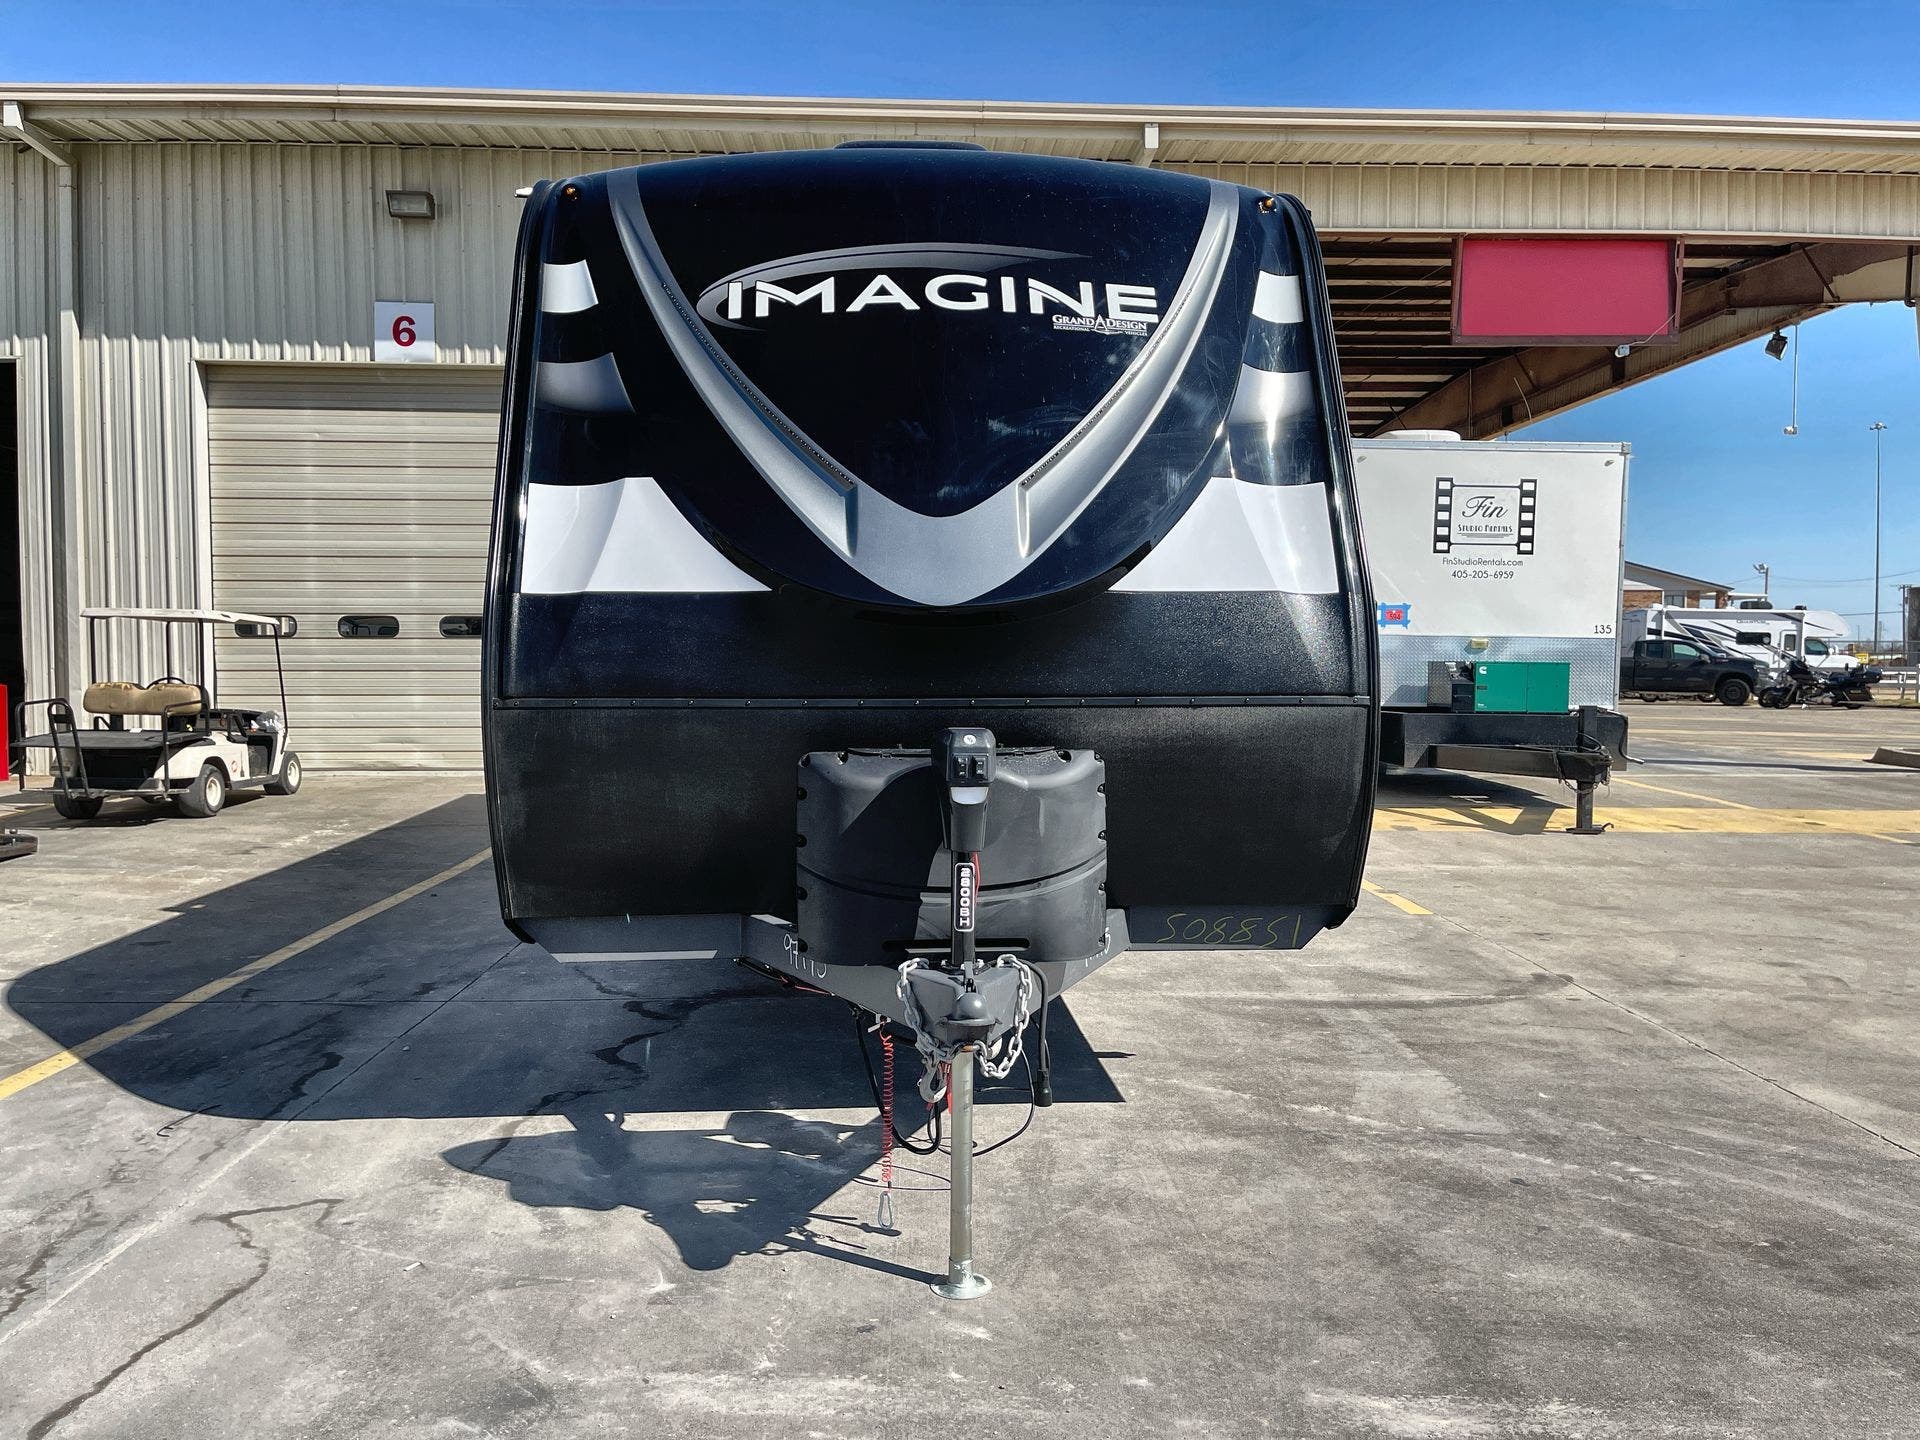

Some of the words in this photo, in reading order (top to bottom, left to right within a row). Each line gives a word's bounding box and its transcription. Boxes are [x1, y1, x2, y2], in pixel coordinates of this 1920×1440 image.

[727, 274, 1159, 323] IMAGINE
[393, 315, 417, 347] 6
[1052, 314, 1095, 326] GRAND
[1106, 318, 1147, 330] DESIGN
[1462, 496, 1508, 518] Fin
[1442, 557, 1524, 566] FinStudioRentals.com
[1451, 570, 1514, 579] 405-205-6959
[1594, 624, 1612, 634] 135
[959, 867, 971, 927] 2800BH
